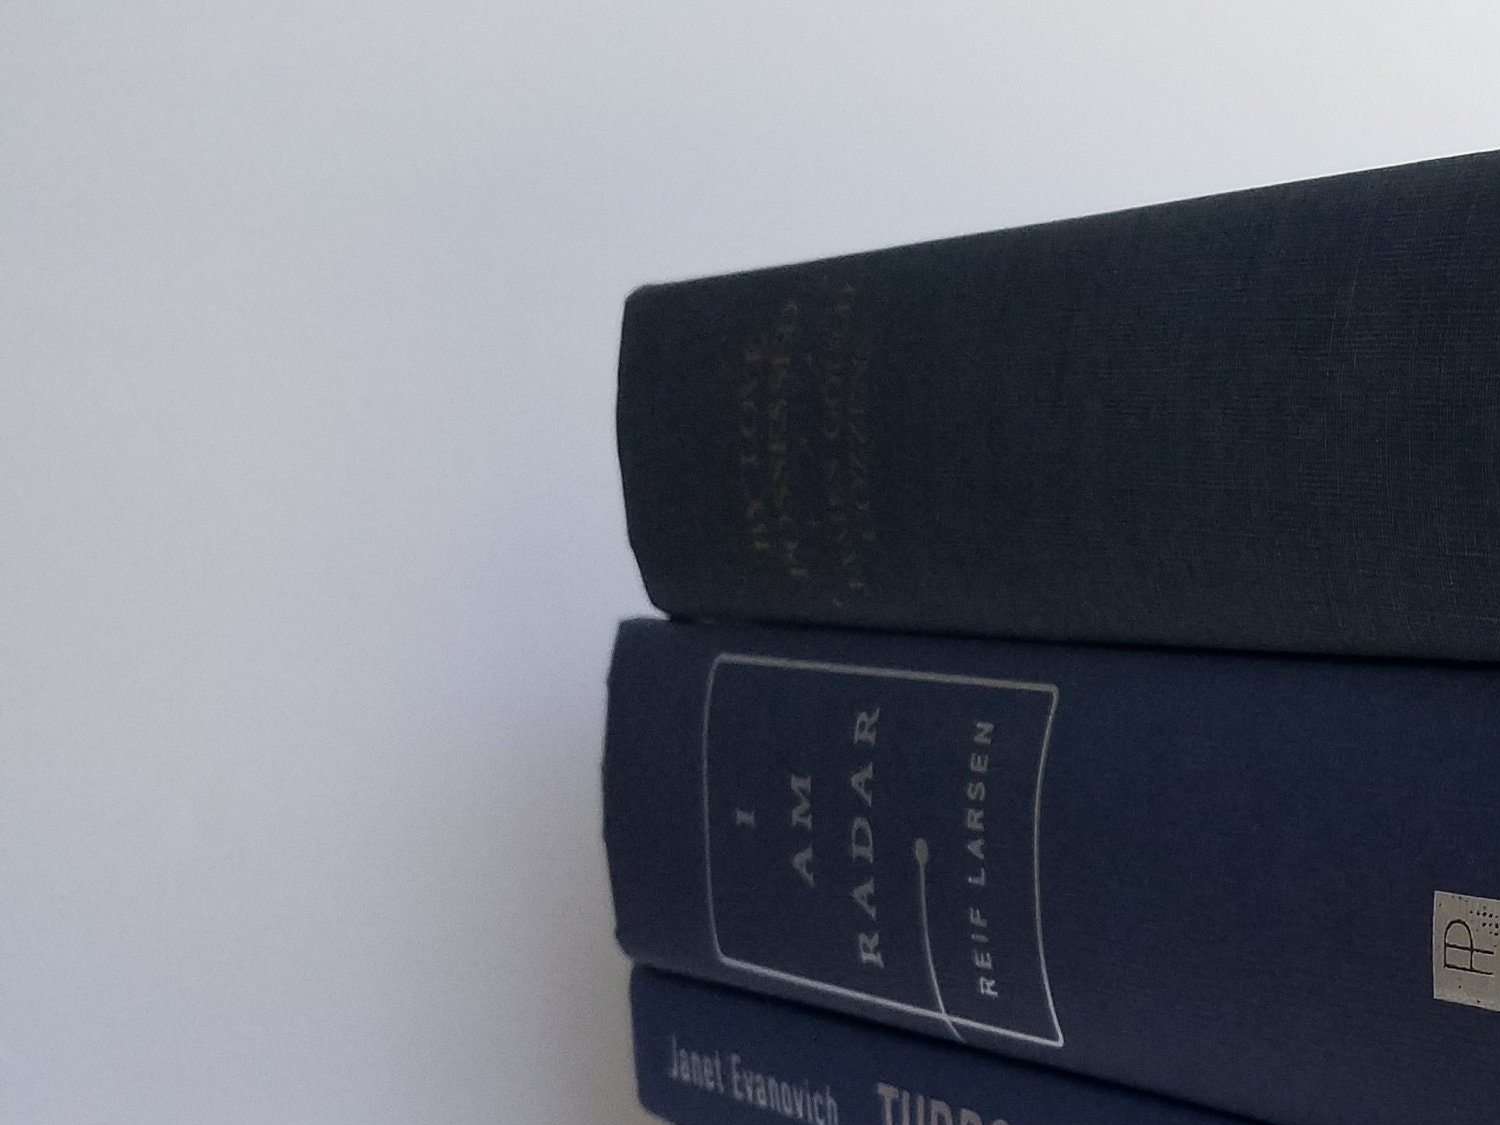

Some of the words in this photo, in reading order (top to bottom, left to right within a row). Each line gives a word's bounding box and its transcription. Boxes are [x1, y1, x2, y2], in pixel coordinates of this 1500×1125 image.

[736, 809, 756, 828] I
[791, 774, 815, 888] AM
[849, 707, 884, 968] RADAR
[967, 721, 994, 887] LARSEN
[969, 908, 998, 998] REIF
[669, 1037, 725, 1096] Janet
